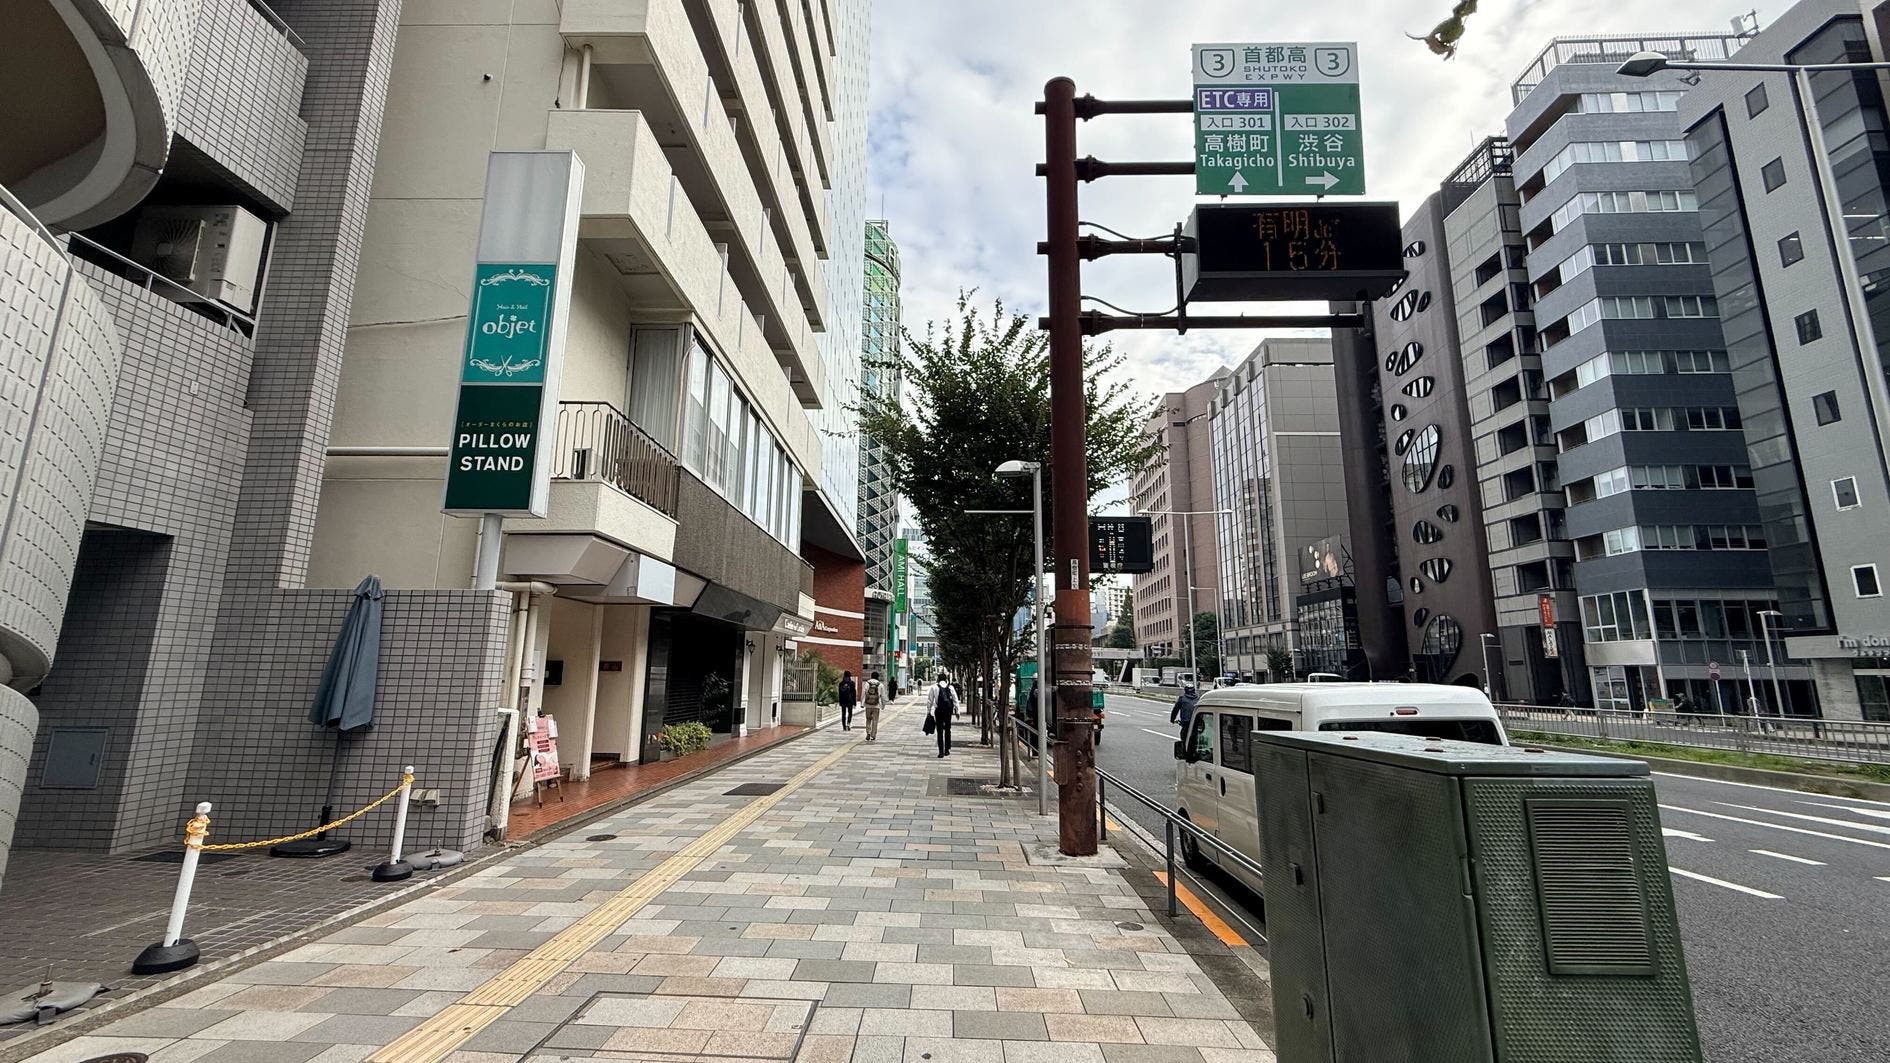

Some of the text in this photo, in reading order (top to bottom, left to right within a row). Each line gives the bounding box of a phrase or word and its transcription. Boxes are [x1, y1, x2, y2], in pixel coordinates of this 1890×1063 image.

[1211, 53, 1226, 72] 3
[1242, 46, 1307, 64] 首都高
[1327, 52, 1340, 71] 3
[1243, 65, 1307, 73] SHUTOKO
[1245, 73, 1306, 81] EXPWY
[1201, 90, 1269, 109] ETC専用
[1206, 117, 1266, 128] 入口 301
[1290, 116, 1350, 128] 入口 302
[1204, 134, 1270, 153] 高樹町
[1299, 134, 1344, 152] 渋谷
[1200, 154, 1275, 170] Takagicho
[1288, 154, 1356, 170] Shibuya
[482, 314, 537, 339] objet
[458, 433, 531, 448] PILLOW
[460, 456, 524, 471] STAND
